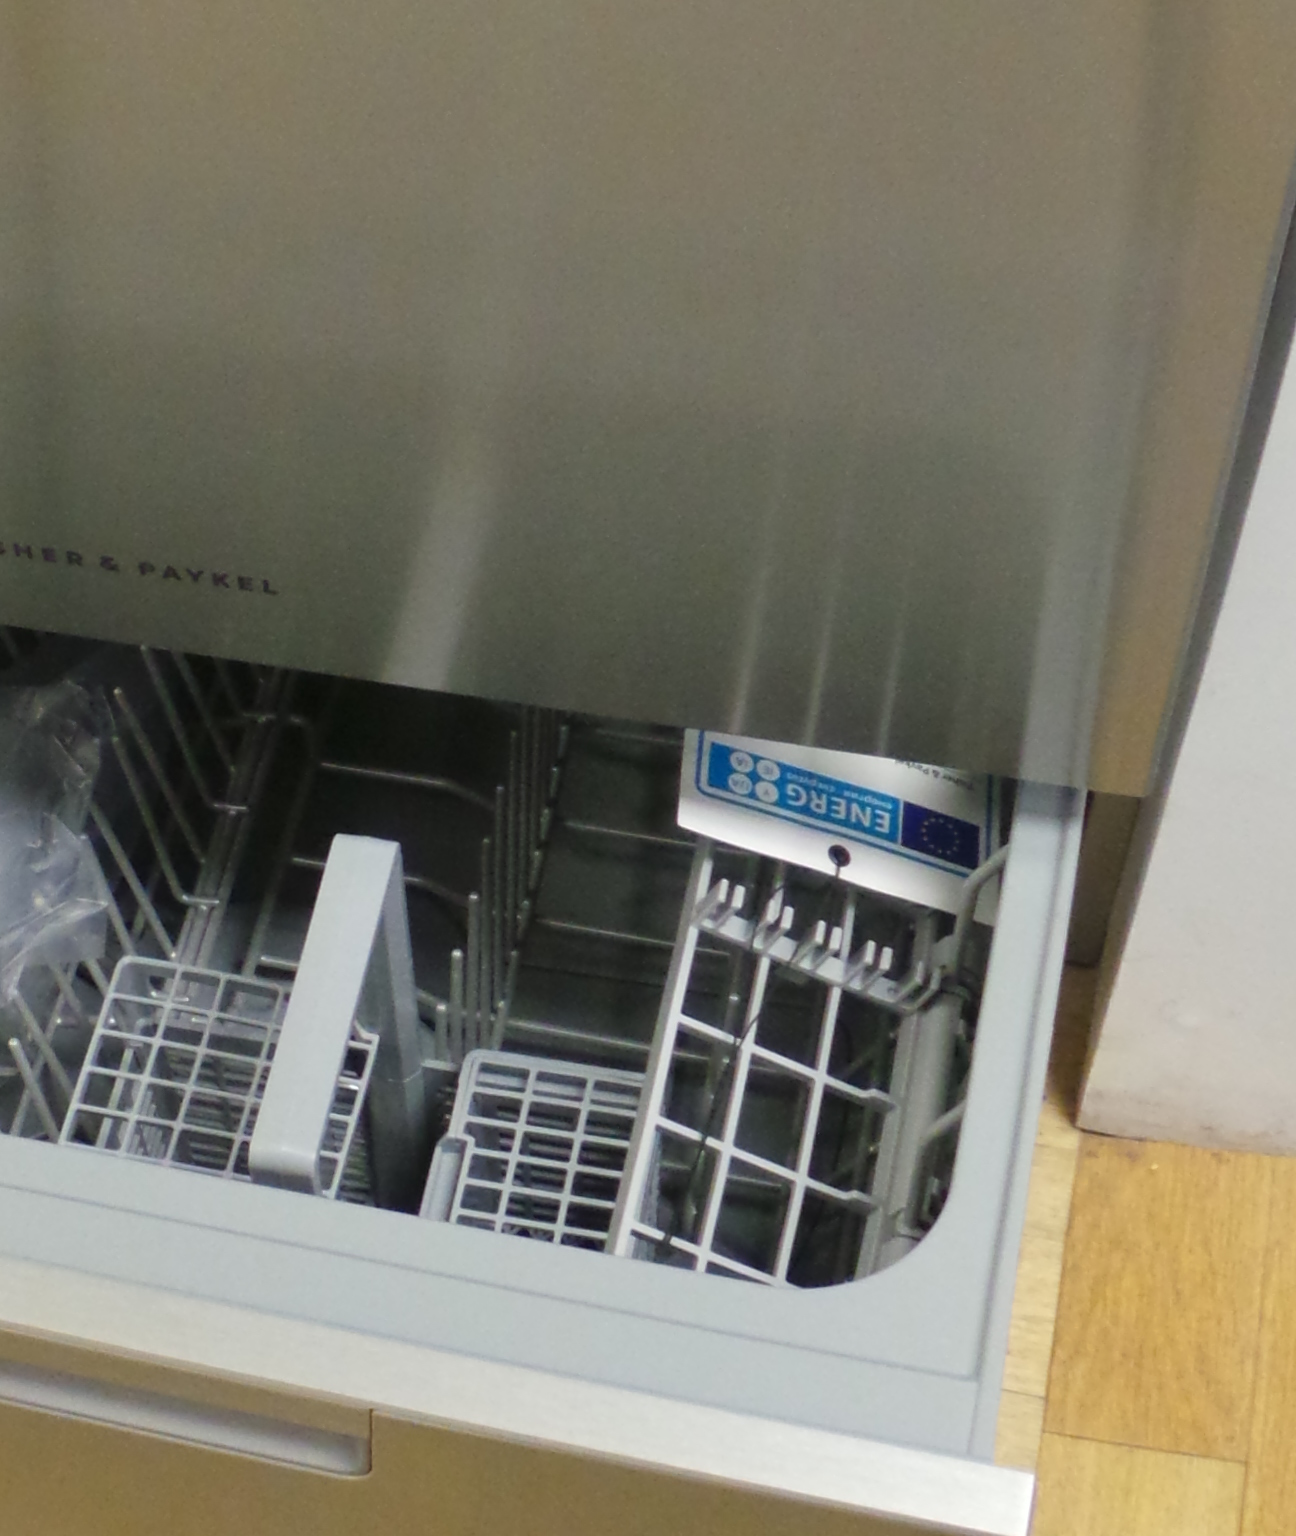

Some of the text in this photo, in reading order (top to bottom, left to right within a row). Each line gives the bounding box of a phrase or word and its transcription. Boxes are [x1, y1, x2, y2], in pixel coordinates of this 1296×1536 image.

[100, 555, 120, 573] &
[138, 561, 279, 595] PAYKEL
[786, 782, 891, 834] ENERG
